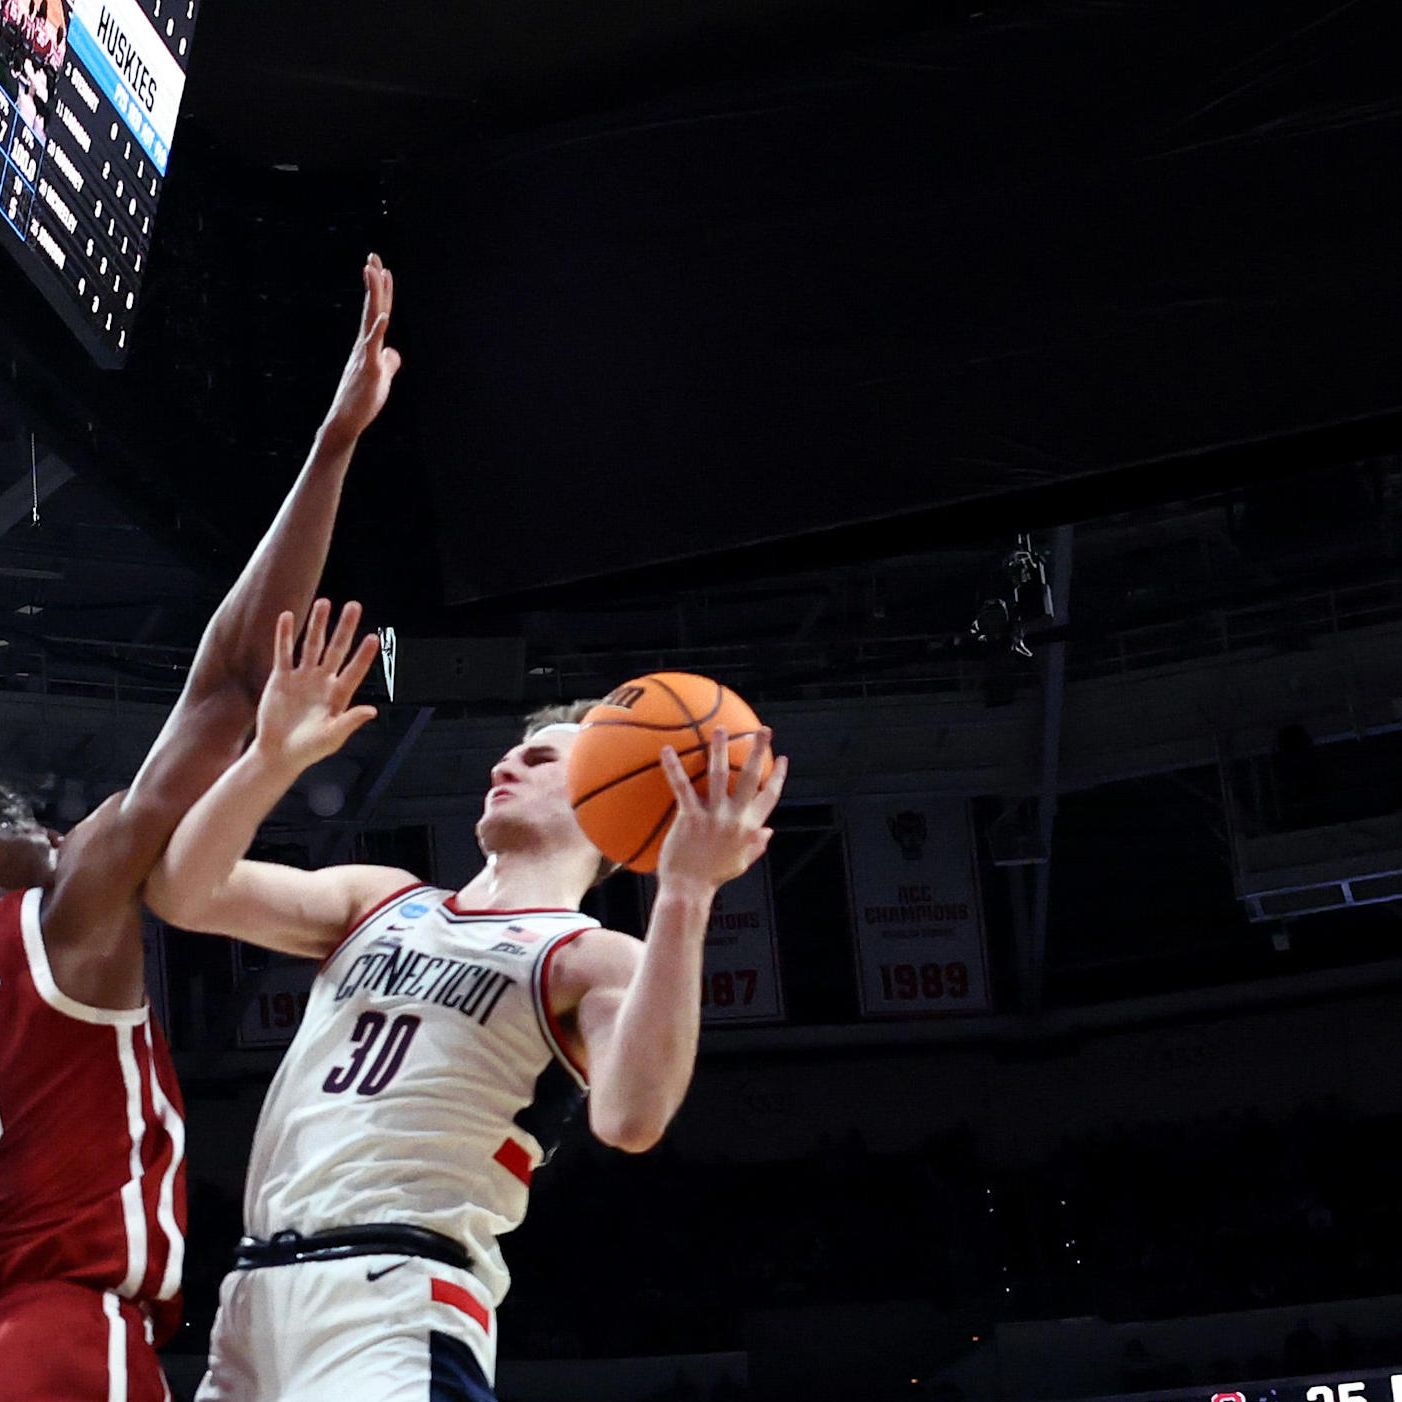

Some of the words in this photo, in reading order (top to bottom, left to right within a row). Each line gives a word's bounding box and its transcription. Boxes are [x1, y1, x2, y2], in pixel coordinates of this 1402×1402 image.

[97, 5, 157, 113] HUSKIES
[864, 904, 969, 925] CHAMPIONS
[880, 961, 969, 1001] 1989
[322, 1010, 423, 1097] 30
